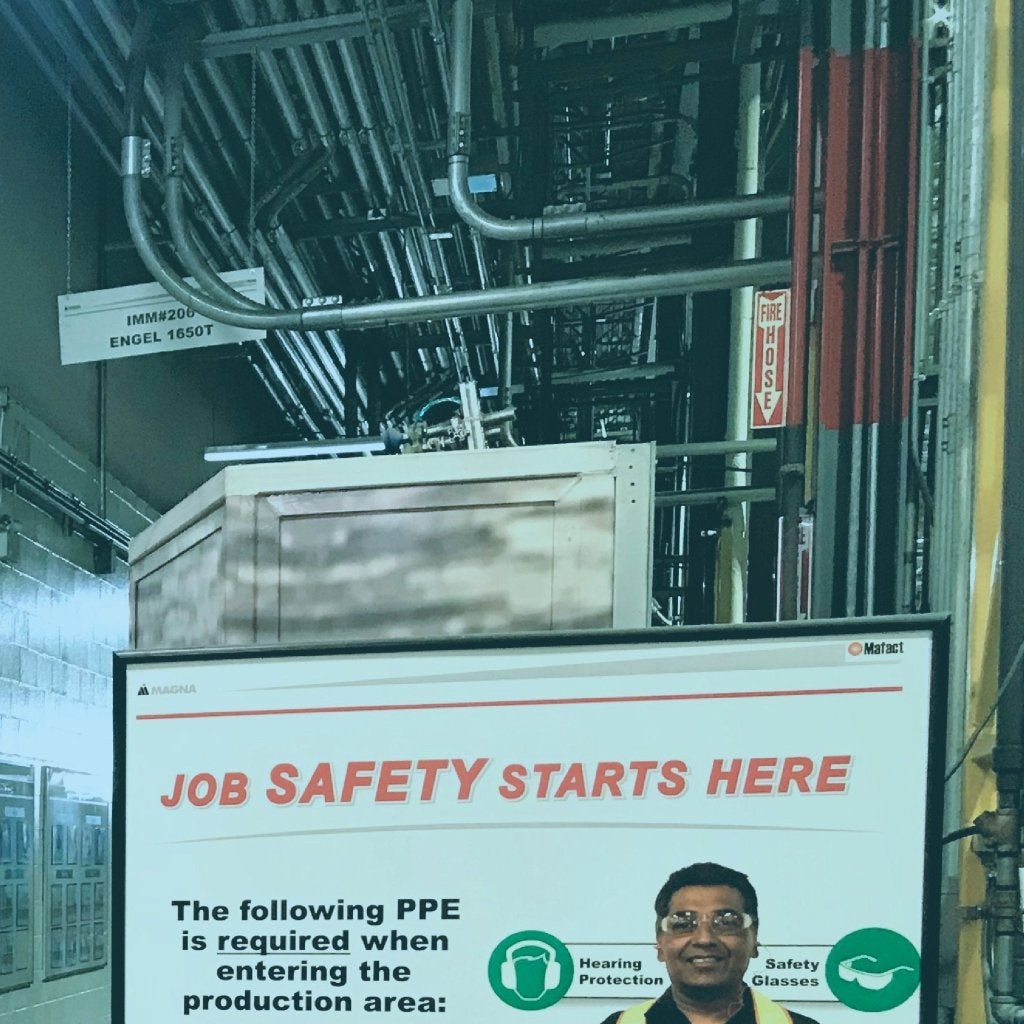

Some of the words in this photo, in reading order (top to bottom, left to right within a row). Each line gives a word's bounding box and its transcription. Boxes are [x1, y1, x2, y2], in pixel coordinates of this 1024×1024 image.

[761, 303, 782, 322] FIRE
[110, 332, 162, 348] ENGEL
[167, 324, 214, 340] 1650T
[764, 325, 776, 410] HOSE
[864, 642, 904, 655] Mafact
[151, 684, 197, 695] MAGNA
[160, 772, 249, 808] JOB
[266, 758, 490, 806] SAFETY
[498, 760, 689, 800] STARTS
[706, 755, 852, 796] HERE
[171, 900, 229, 921] The
[240, 899, 384, 925] following
[397, 899, 461, 920] PPE
[182, 930, 207, 951] is
[217, 930, 350, 955] required
[361, 930, 449, 951] when
[216, 961, 347, 987] entering
[359, 961, 411, 982] the
[579, 957, 642, 972] Hearing
[765, 958, 819, 973] Safety
[579, 973, 664, 987] Protection
[751, 973, 819, 987] Glasses
[183, 990, 352, 1015] production
[364, 996, 446, 1013] area:
